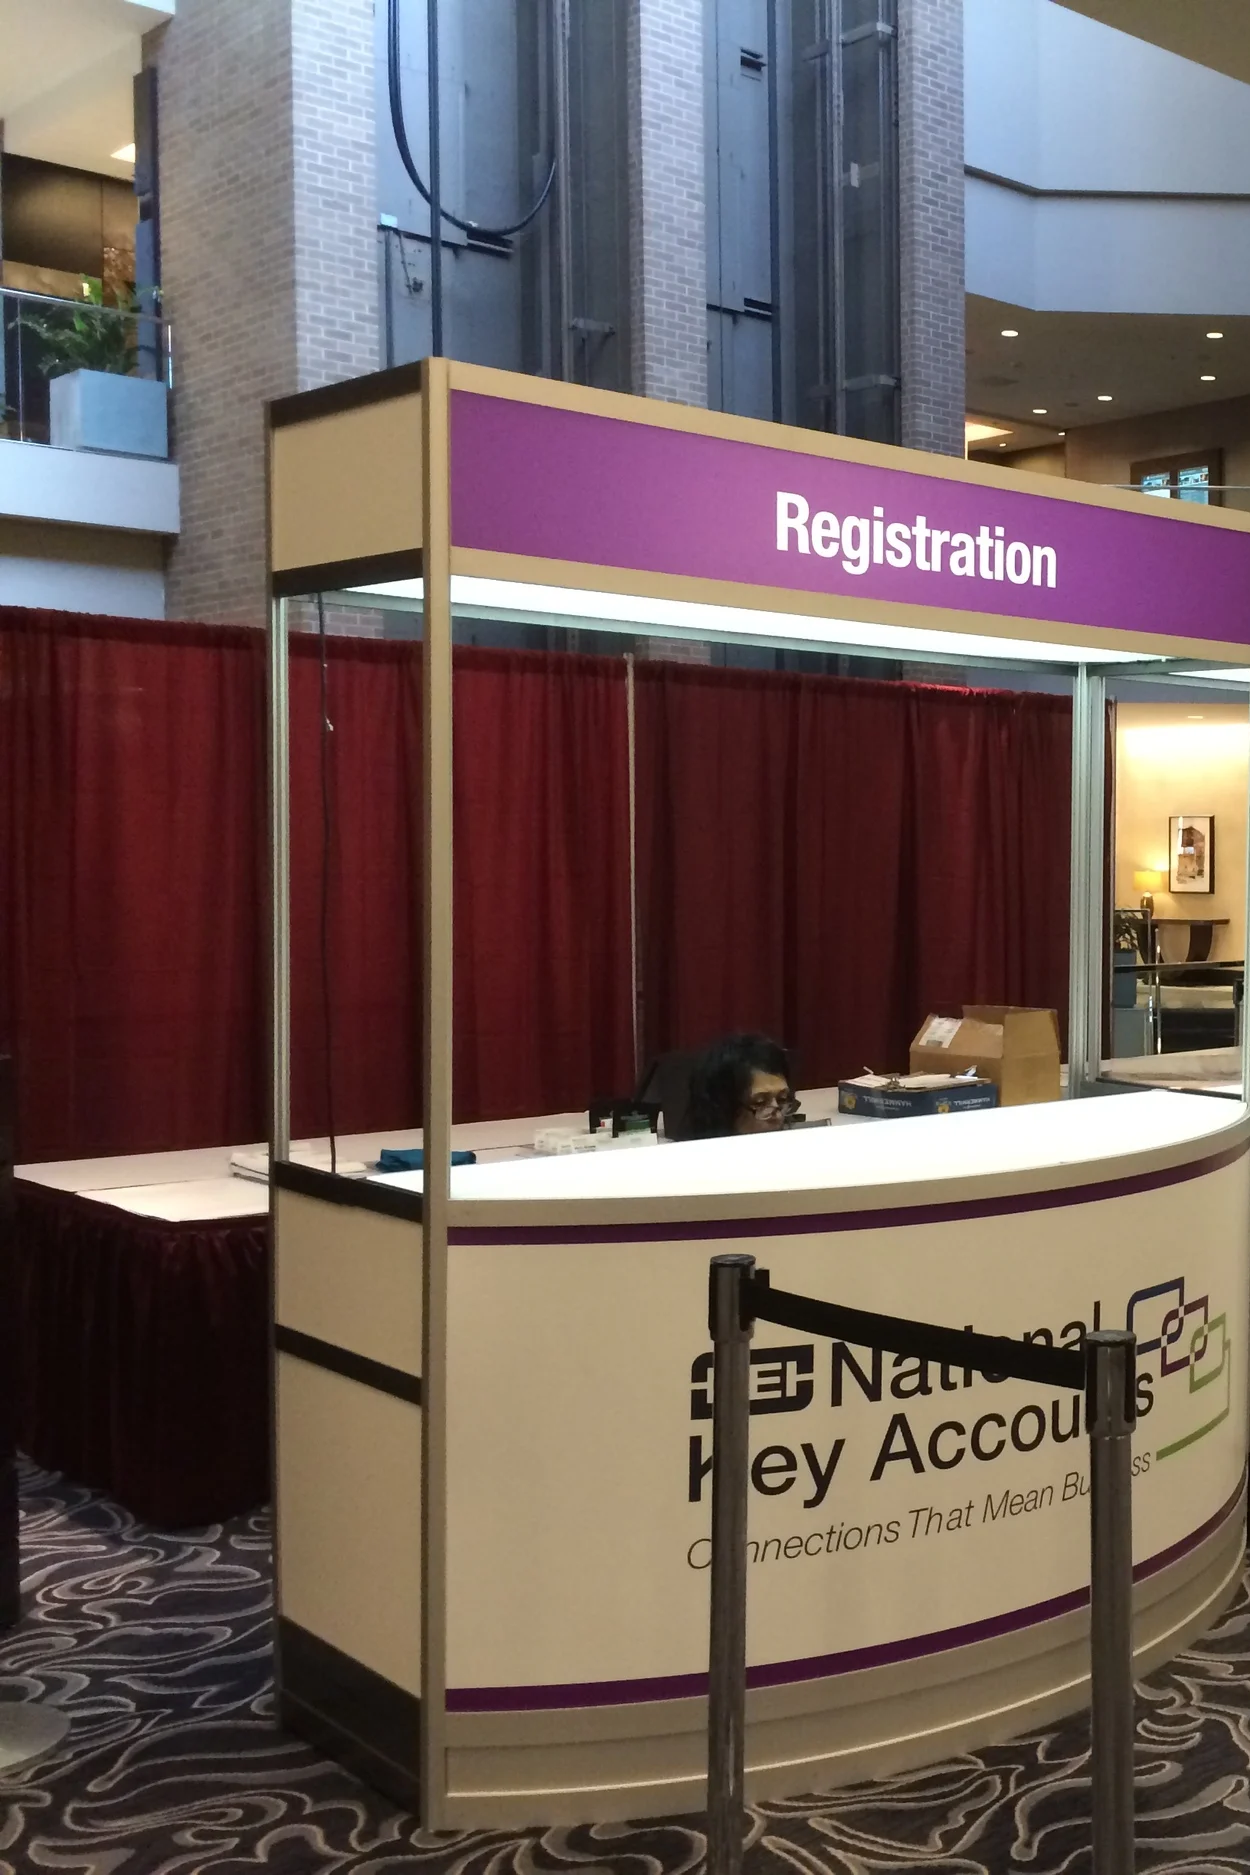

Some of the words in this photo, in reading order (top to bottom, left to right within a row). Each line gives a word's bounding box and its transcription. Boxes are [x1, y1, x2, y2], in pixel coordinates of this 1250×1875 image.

[775, 490, 1058, 589] Registration
[690, 1343, 815, 1421] EI
[831, 1300, 1101, 1407] Naia
[869, 1371, 1155, 1482] Accous
[686, 1520, 901, 1570] Cnnections
[908, 1500, 975, 1539] That
[981, 1484, 1054, 1524] Mean
[1061, 1451, 1152, 1502] Buss
